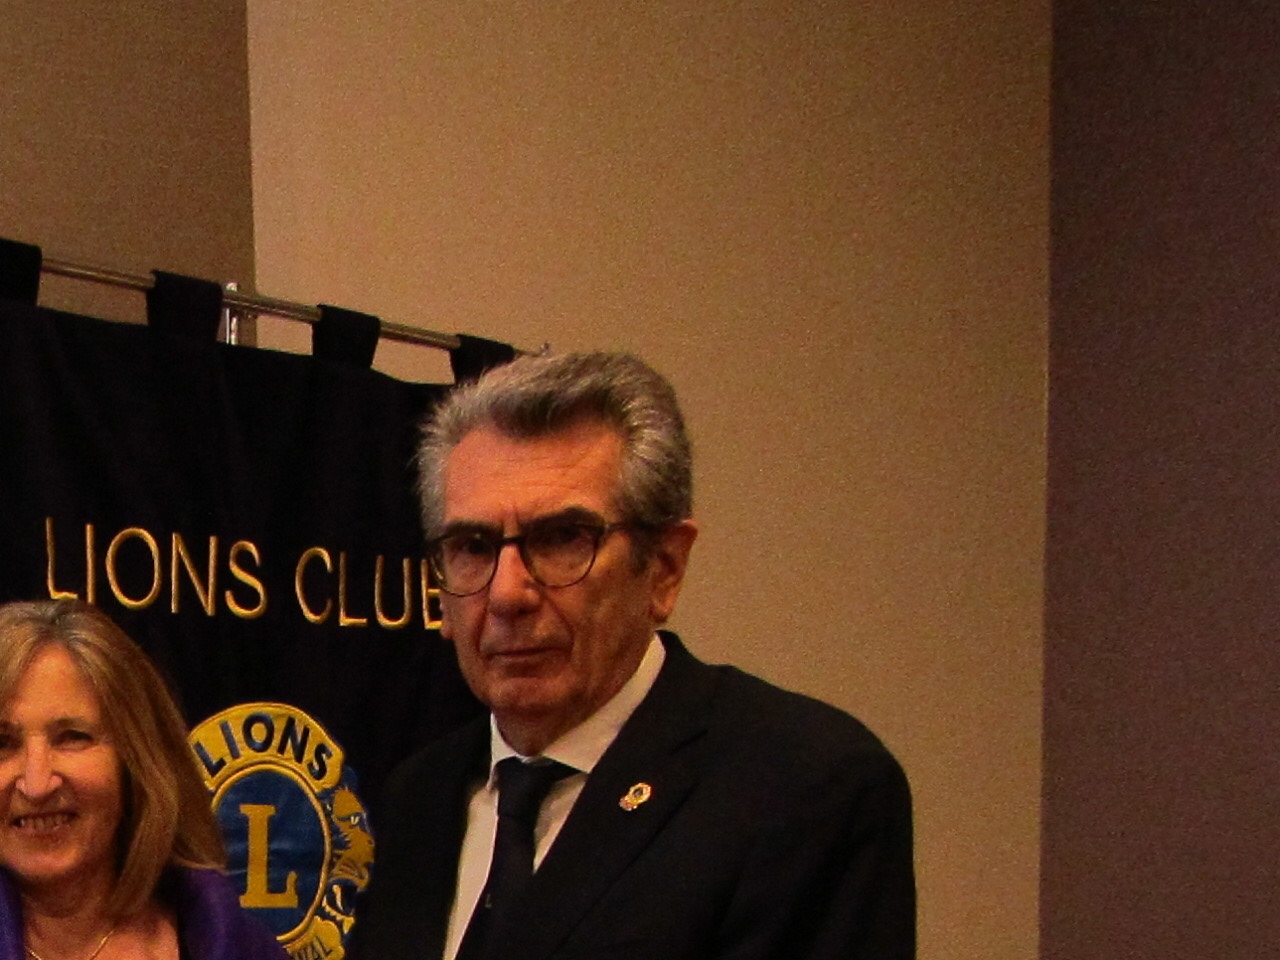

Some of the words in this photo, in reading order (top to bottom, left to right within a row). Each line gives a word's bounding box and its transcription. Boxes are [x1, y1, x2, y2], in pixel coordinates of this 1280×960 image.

[45, 516, 268, 619] LIONS
[195, 714, 333, 780] LIONS
[239, 804, 299, 909] L
